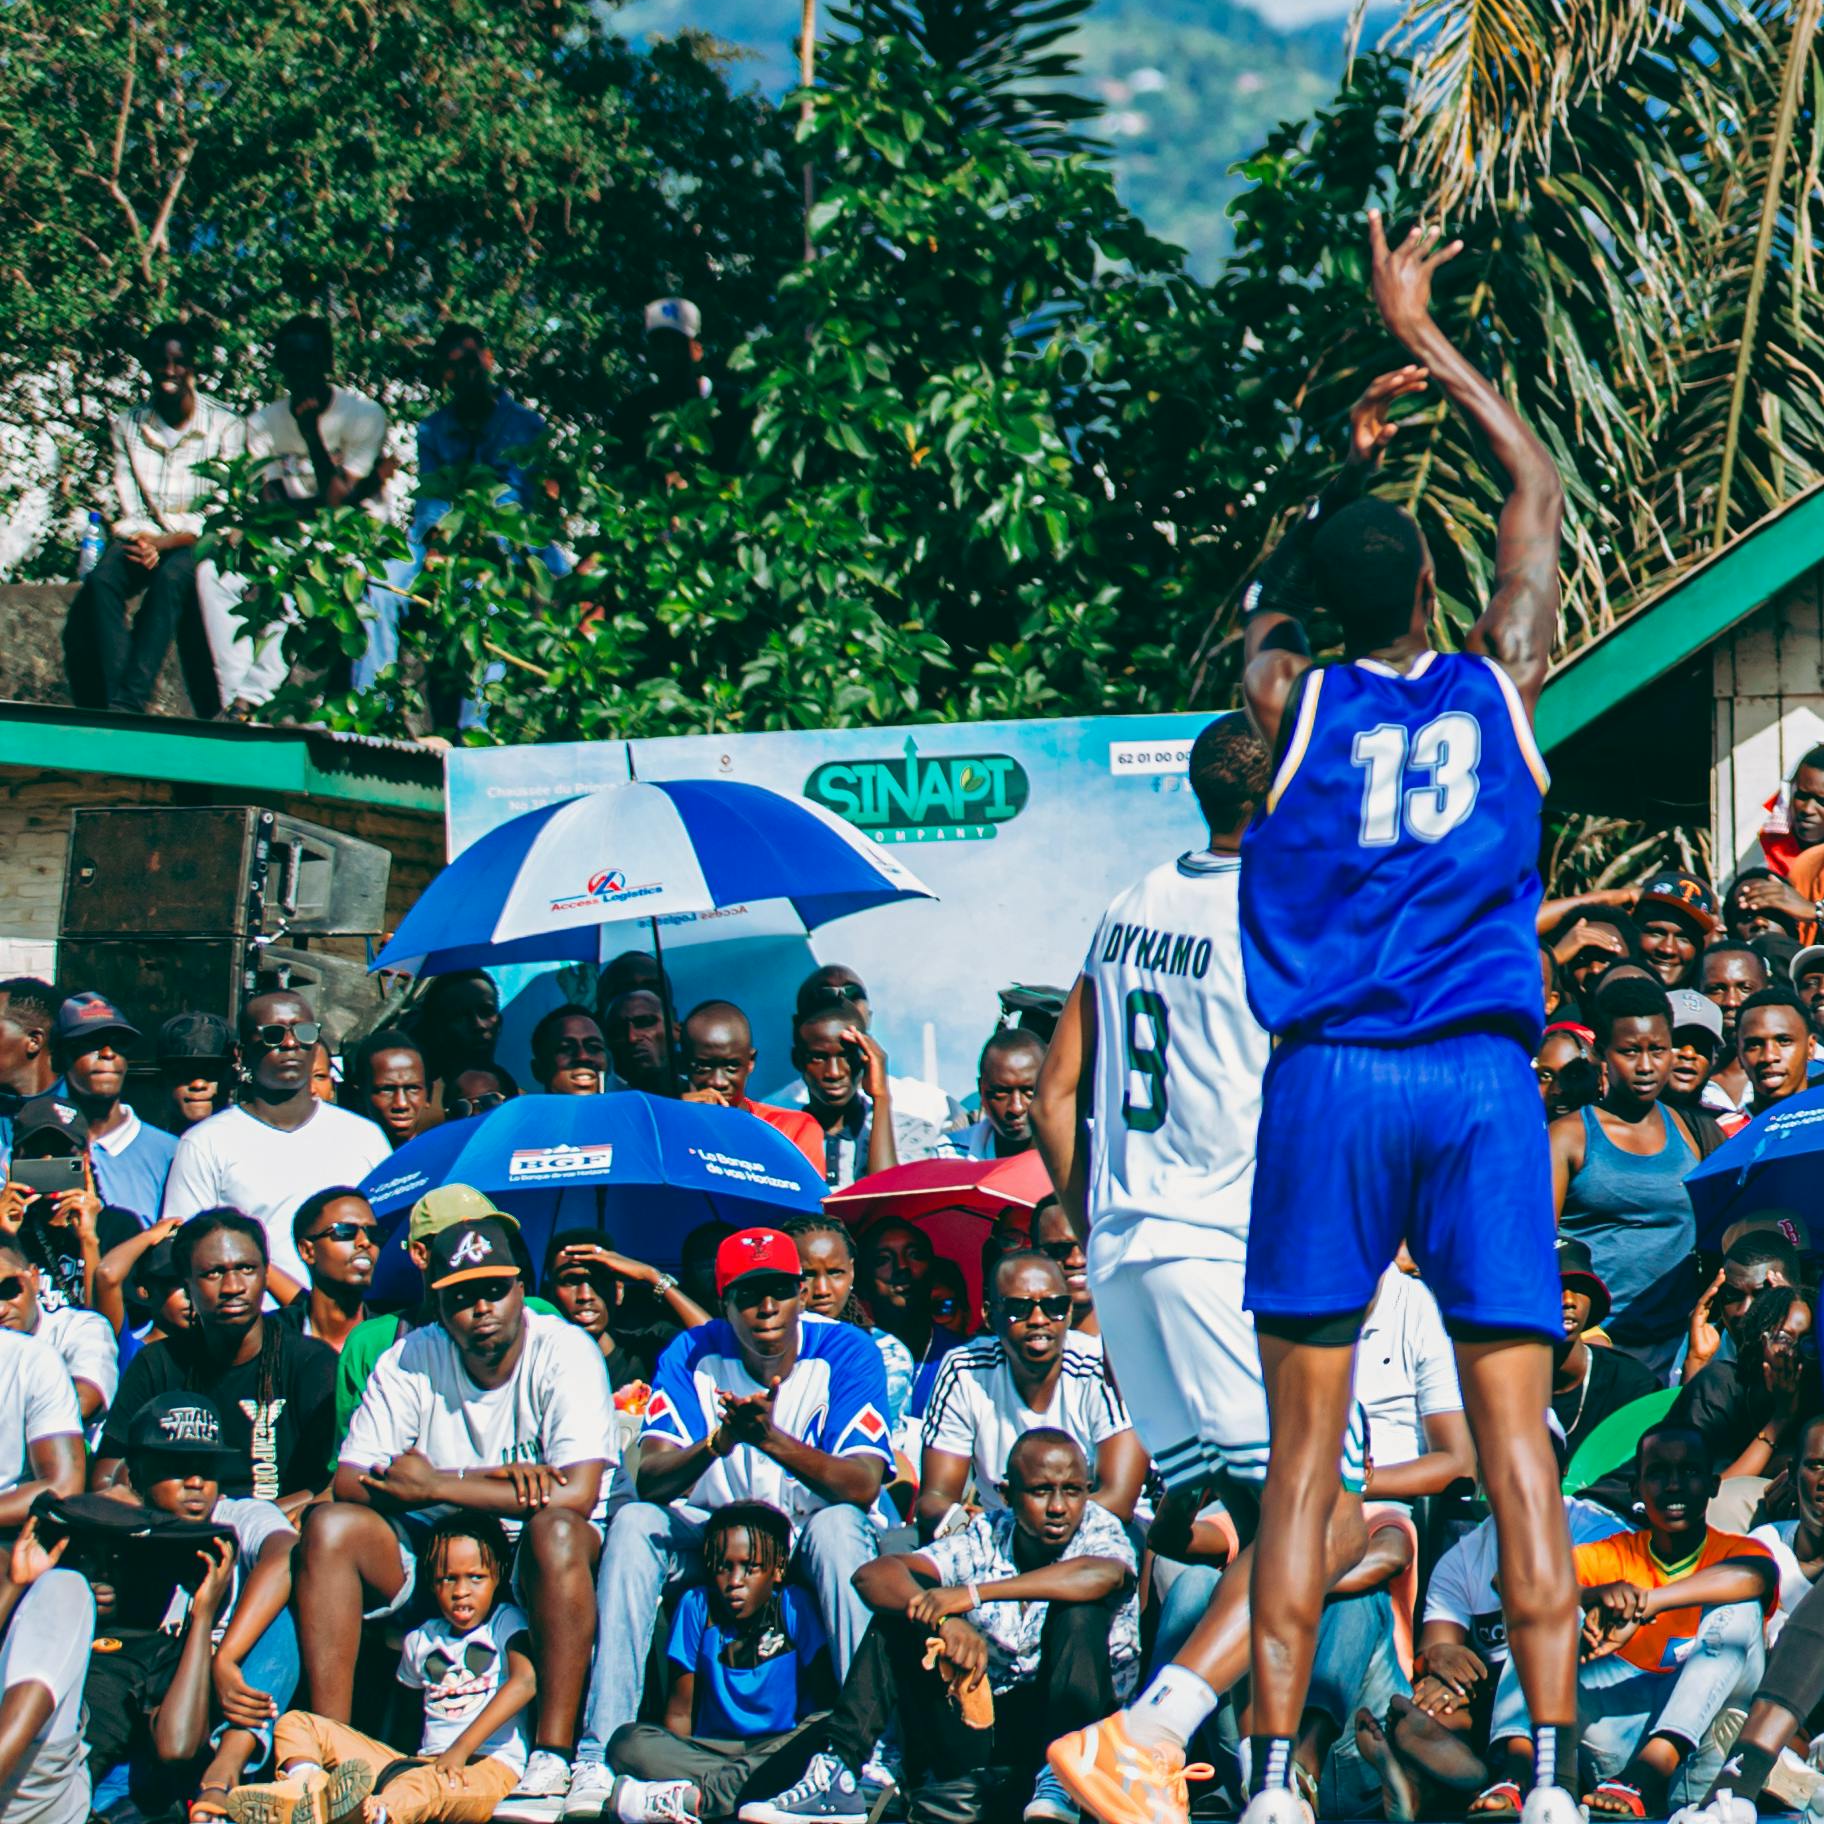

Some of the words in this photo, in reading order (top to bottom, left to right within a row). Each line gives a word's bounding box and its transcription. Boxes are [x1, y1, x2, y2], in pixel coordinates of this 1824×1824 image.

[818, 754, 1014, 825] SINAPI
[1350, 711, 1482, 849] 13
[876, 826, 986, 843] OMPANY
[551, 898, 599, 912] Access
[603, 886, 663, 903] Logistics
[1103, 925, 1213, 980] DYNAMO
[1120, 988, 1170, 1133] 9
[520, 1155, 607, 1170] BGF
